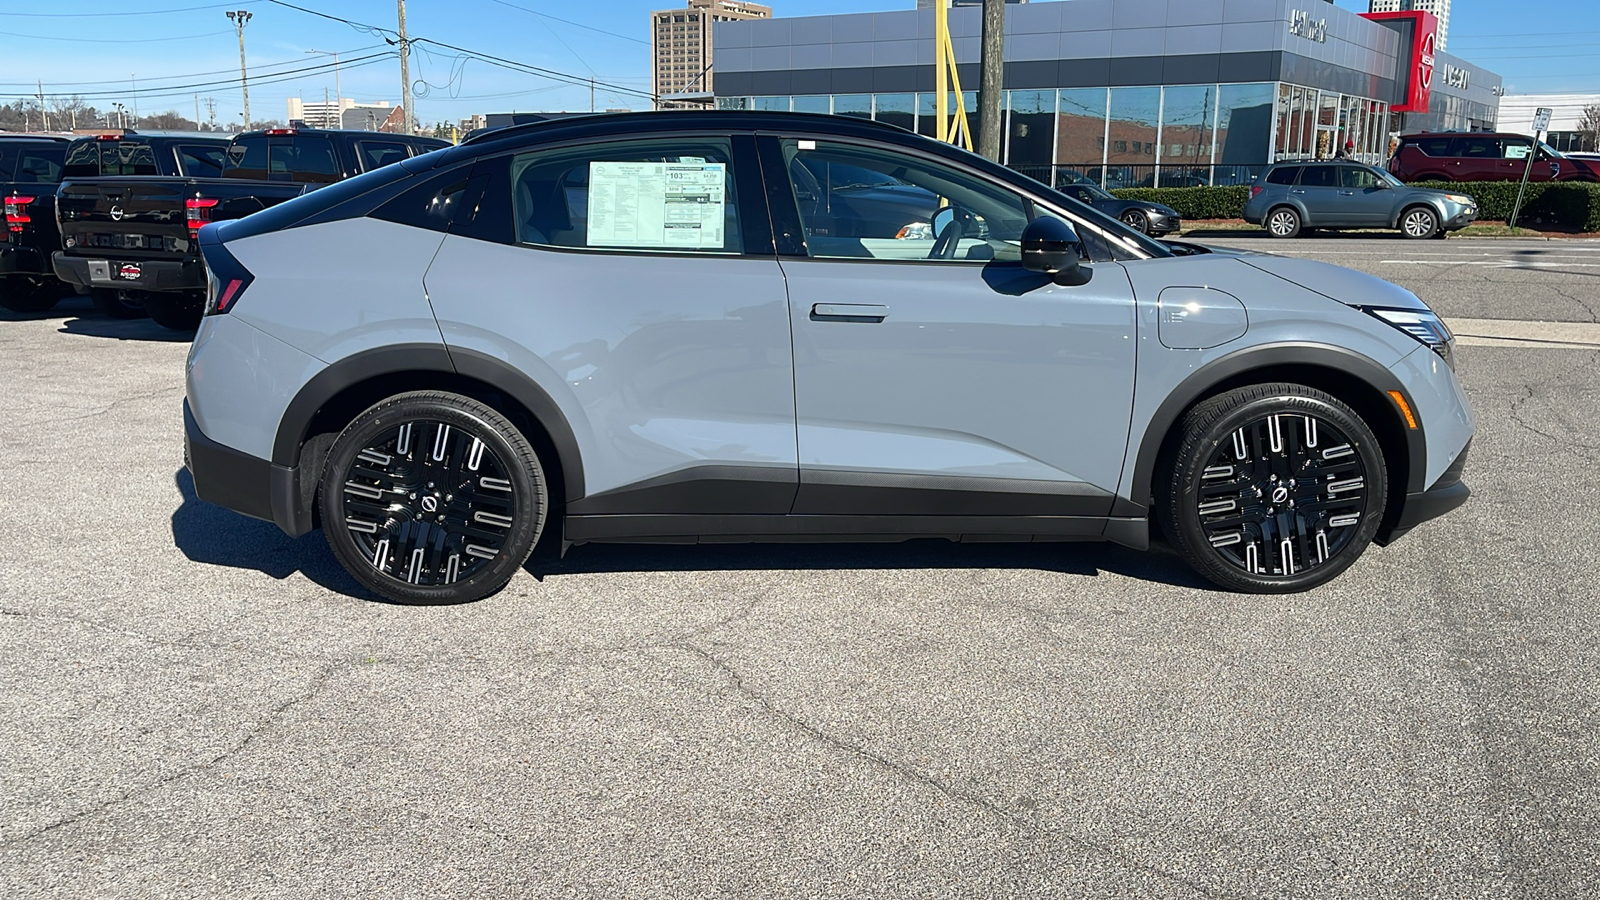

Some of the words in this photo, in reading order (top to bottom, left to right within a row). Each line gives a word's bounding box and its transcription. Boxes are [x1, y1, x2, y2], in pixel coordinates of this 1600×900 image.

[1290, 9, 1328, 44] Hallmark
[1442, 63, 1471, 90] NISSAN
[670, 172, 683, 180] 103
[1286, 397, 1359, 436] BRIDGESTONE
